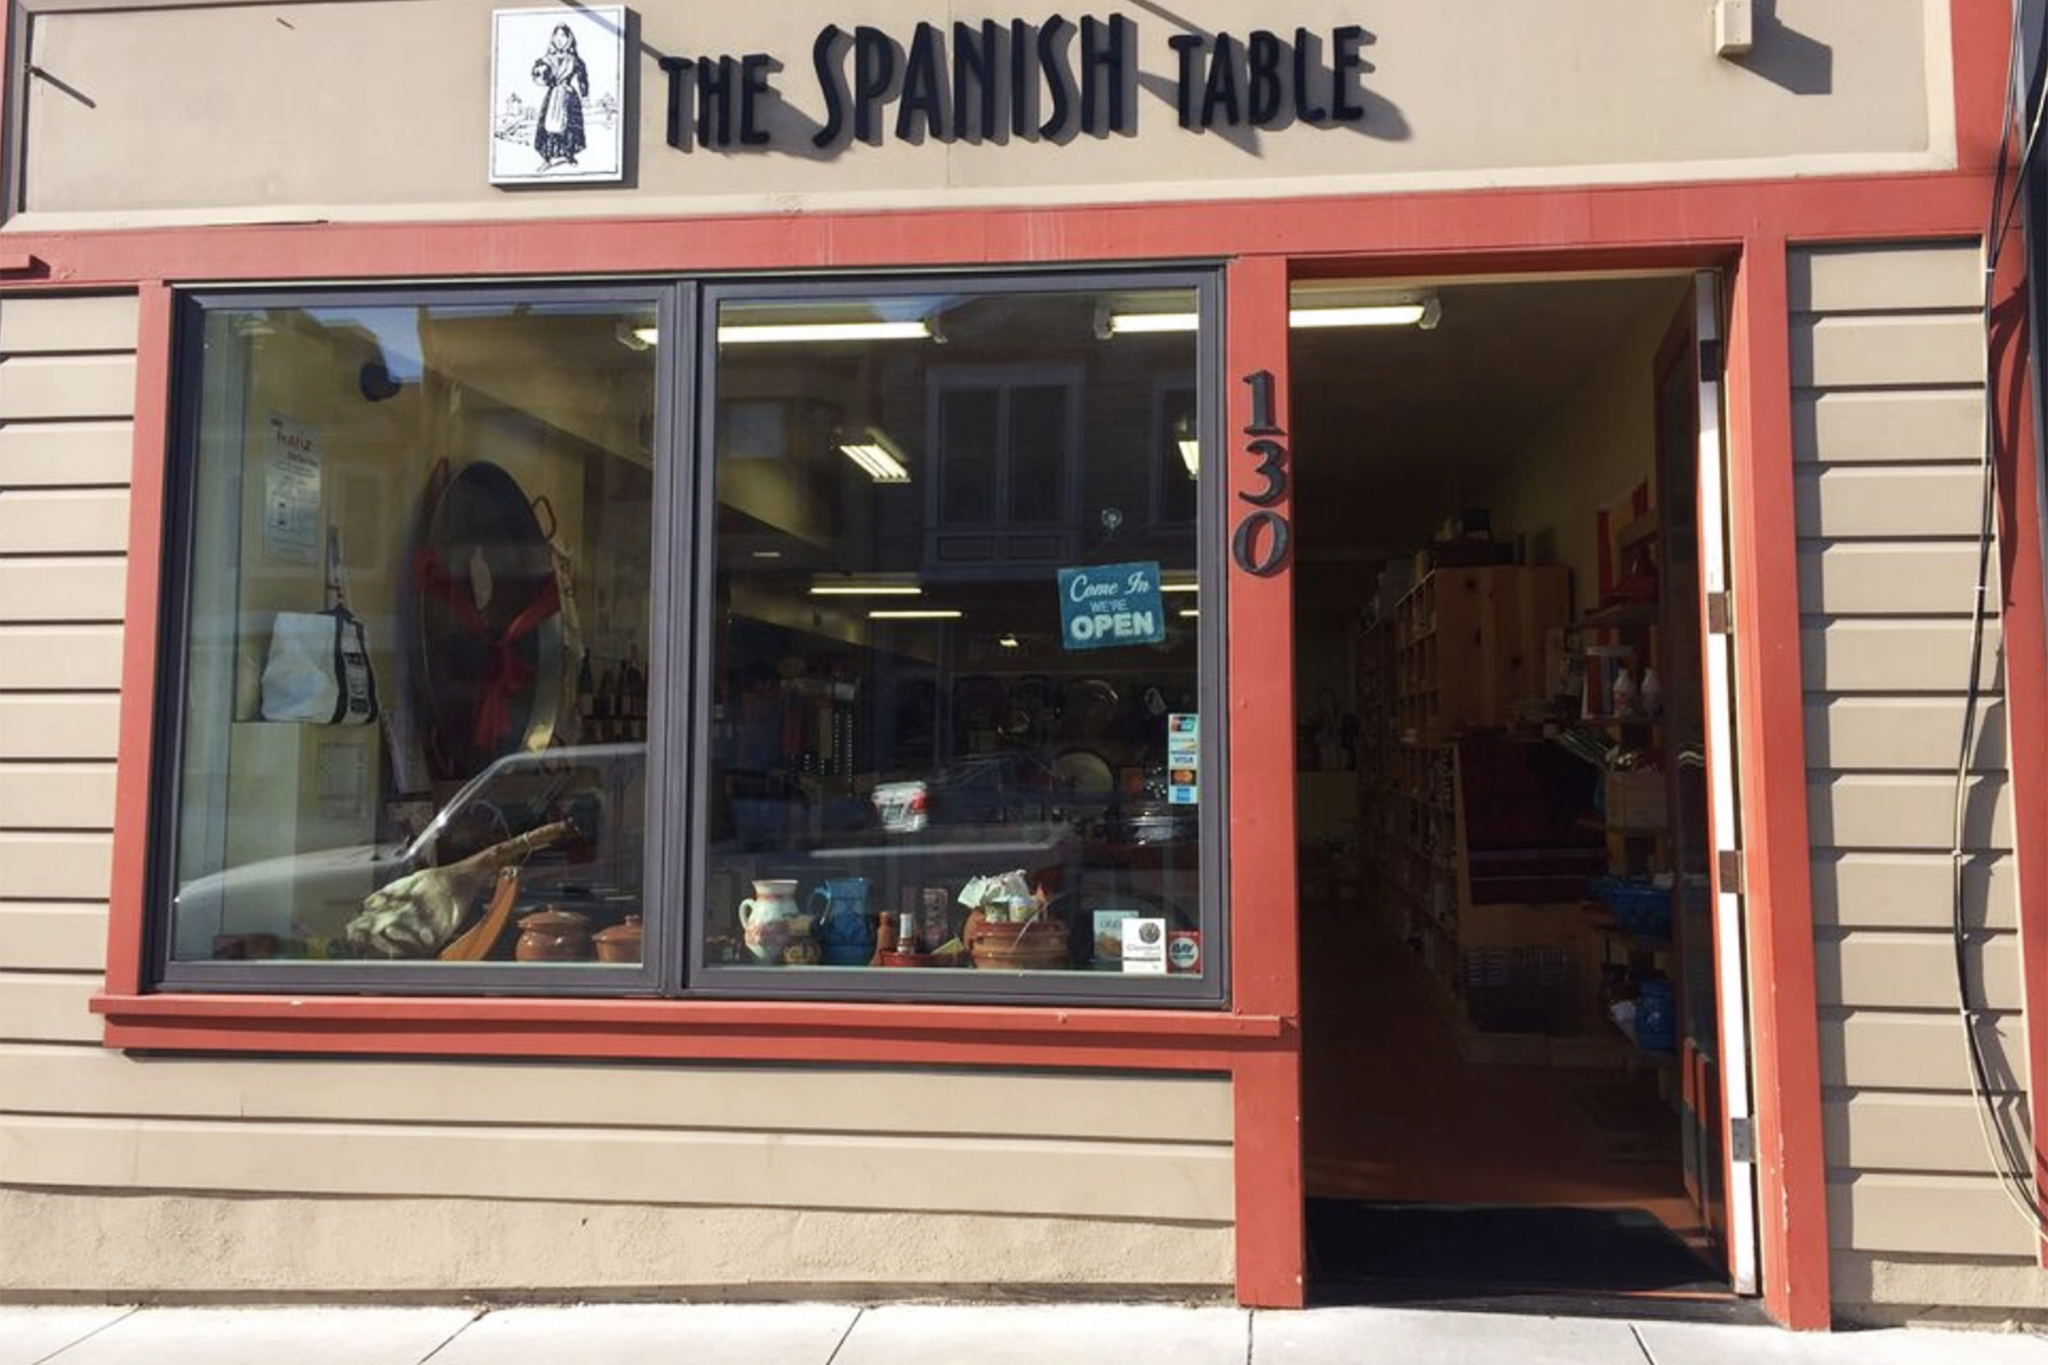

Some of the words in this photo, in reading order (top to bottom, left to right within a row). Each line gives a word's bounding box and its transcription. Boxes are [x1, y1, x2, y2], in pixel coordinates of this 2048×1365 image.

[658, 54, 770, 148] THE
[812, 13, 1124, 148] SPANISH
[1168, 25, 1363, 129] TABLE
[1232, 369, 1290, 579] 130
[1070, 574, 1118, 602] Come
[1124, 571, 1150, 595] In
[1070, 611, 1155, 640] OPEN
